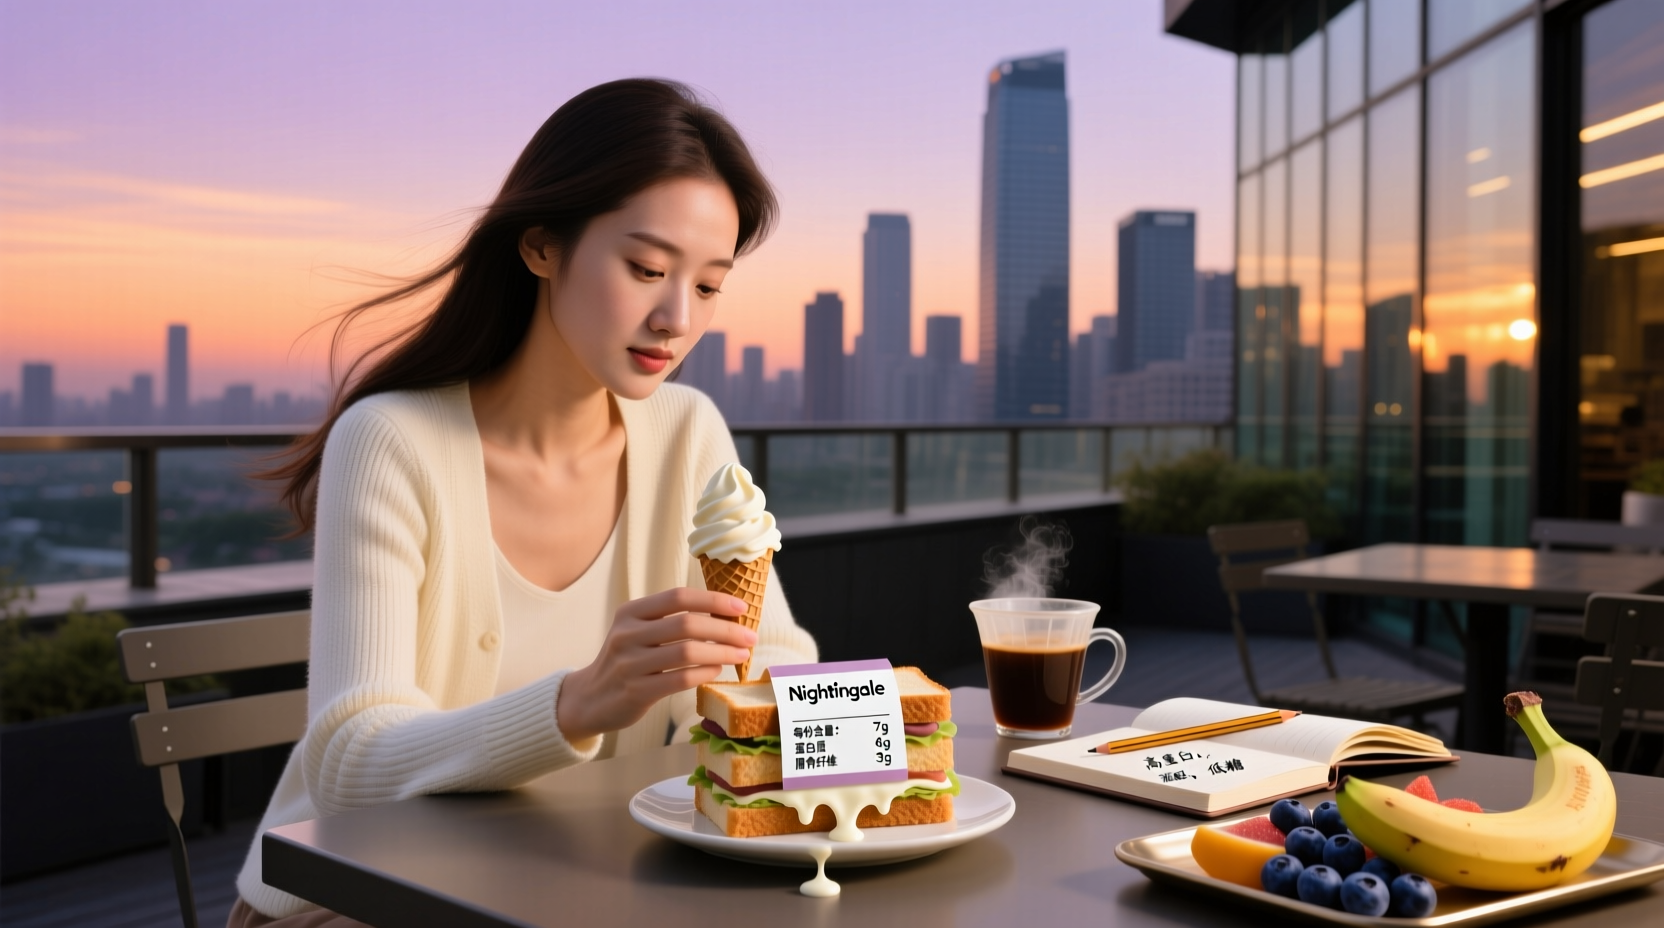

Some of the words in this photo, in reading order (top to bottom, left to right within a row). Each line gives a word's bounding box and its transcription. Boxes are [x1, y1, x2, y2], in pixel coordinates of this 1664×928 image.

[788, 679, 885, 705] Nightingale
[873, 721, 889, 736] 7g
[875, 752, 892, 766] 3g
